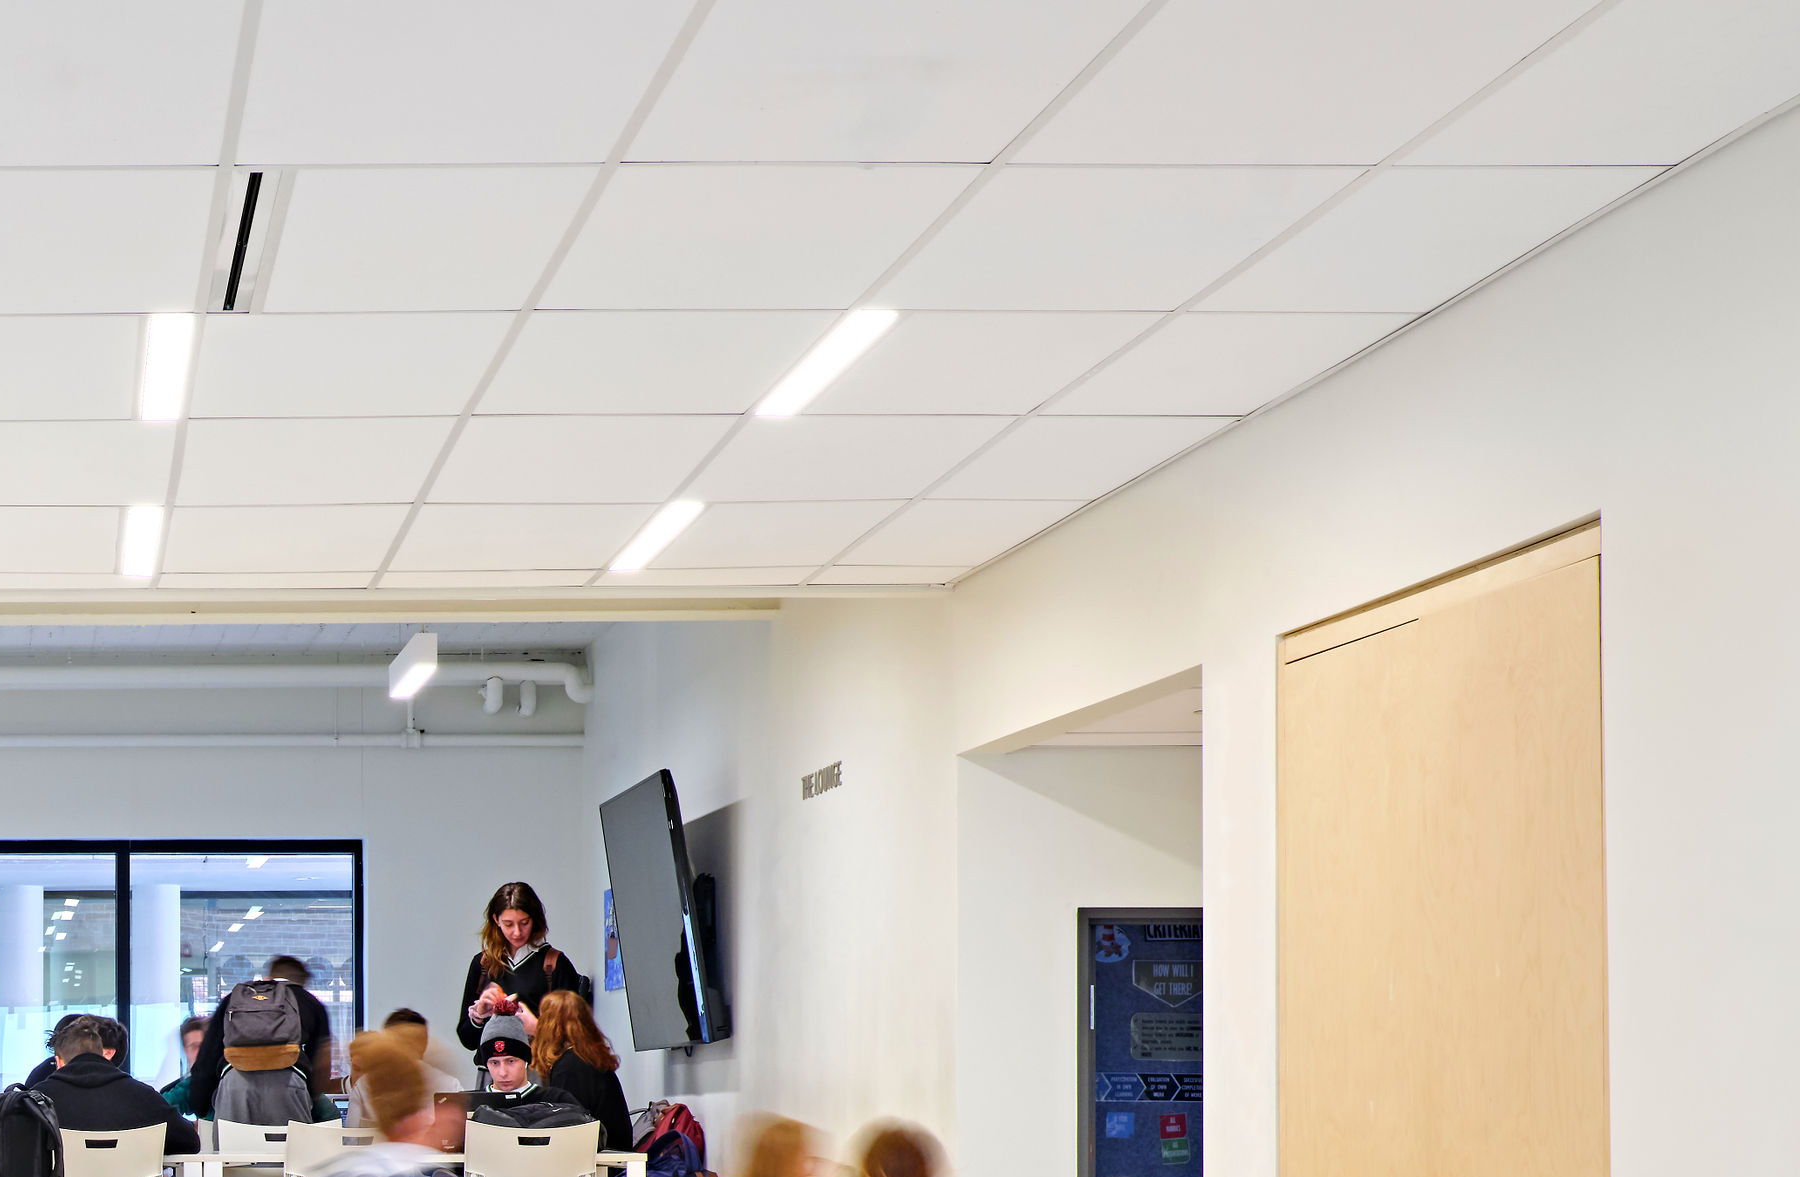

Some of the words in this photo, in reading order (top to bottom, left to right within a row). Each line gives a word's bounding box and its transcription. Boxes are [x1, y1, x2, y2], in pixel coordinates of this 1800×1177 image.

[814, 760, 842, 796] LOUNGE
[1153, 964, 1170, 977] HOW
[1172, 964, 1188, 977] WILL
[1190, 964, 1194, 977] I
[1154, 982, 1166, 995] GET
